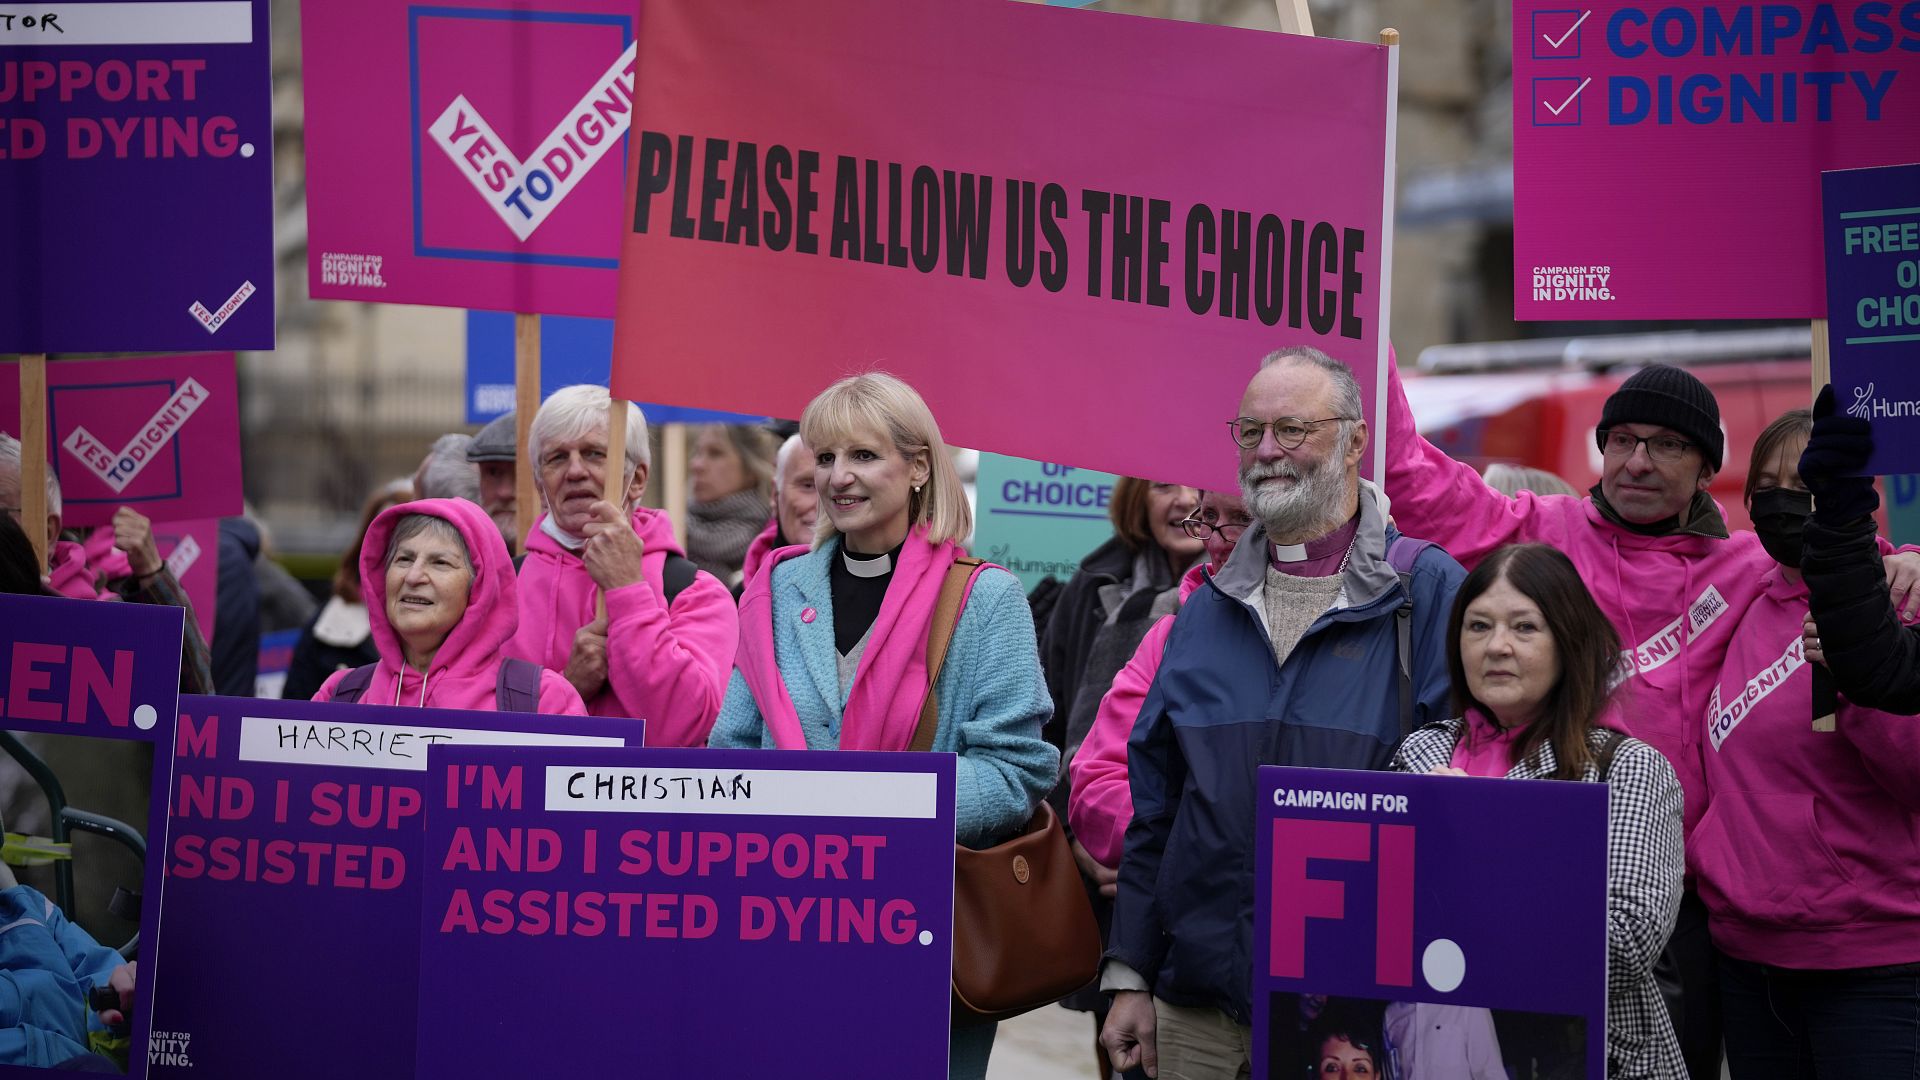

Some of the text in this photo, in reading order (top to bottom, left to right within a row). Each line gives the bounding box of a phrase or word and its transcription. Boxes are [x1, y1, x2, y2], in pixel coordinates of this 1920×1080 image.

[1608, 70, 1899, 126] DIGNITY
[0, 115, 255, 160] D DYING.
[449, 109, 515, 192] YES
[633, 130, 1365, 340] PLEASE ALLOW US THE CHOICE
[1845, 222, 1920, 255] FREE
[322, 252, 382, 263] CAMPAIGN FOR
[322, 259, 382, 274] DIGNITY
[1533, 266, 1610, 275] CAMPAIGN FOR
[322, 271, 337, 285] IN
[1533, 274, 1610, 288] DIGNITY
[1897, 260, 1920, 289] O
[1533, 287, 1616, 301] IN DYING.
[192, 303, 211, 323] YES
[73, 432, 112, 473] YES
[1002, 479, 1113, 508] CHOICE
[1692, 594, 1717, 622] DIGNITY
[0, 641, 157, 730] EN.
[277, 725, 453, 758] HARRIET
[169, 774, 425, 832] ND I SUP
[446, 764, 752, 810] I'M CHRISTIAN
[1273, 788, 1409, 813] CAMPAIGN FOR
[164, 834, 407, 891] SSISTED
[442, 826, 887, 880] AND I SUPPORT
[440, 888, 934, 946] ASSISTED DYING.
[1269, 817, 1466, 993] FI.
[149, 1038, 190, 1054] NITY
[150, 1030, 191, 1041] IGN FOR
